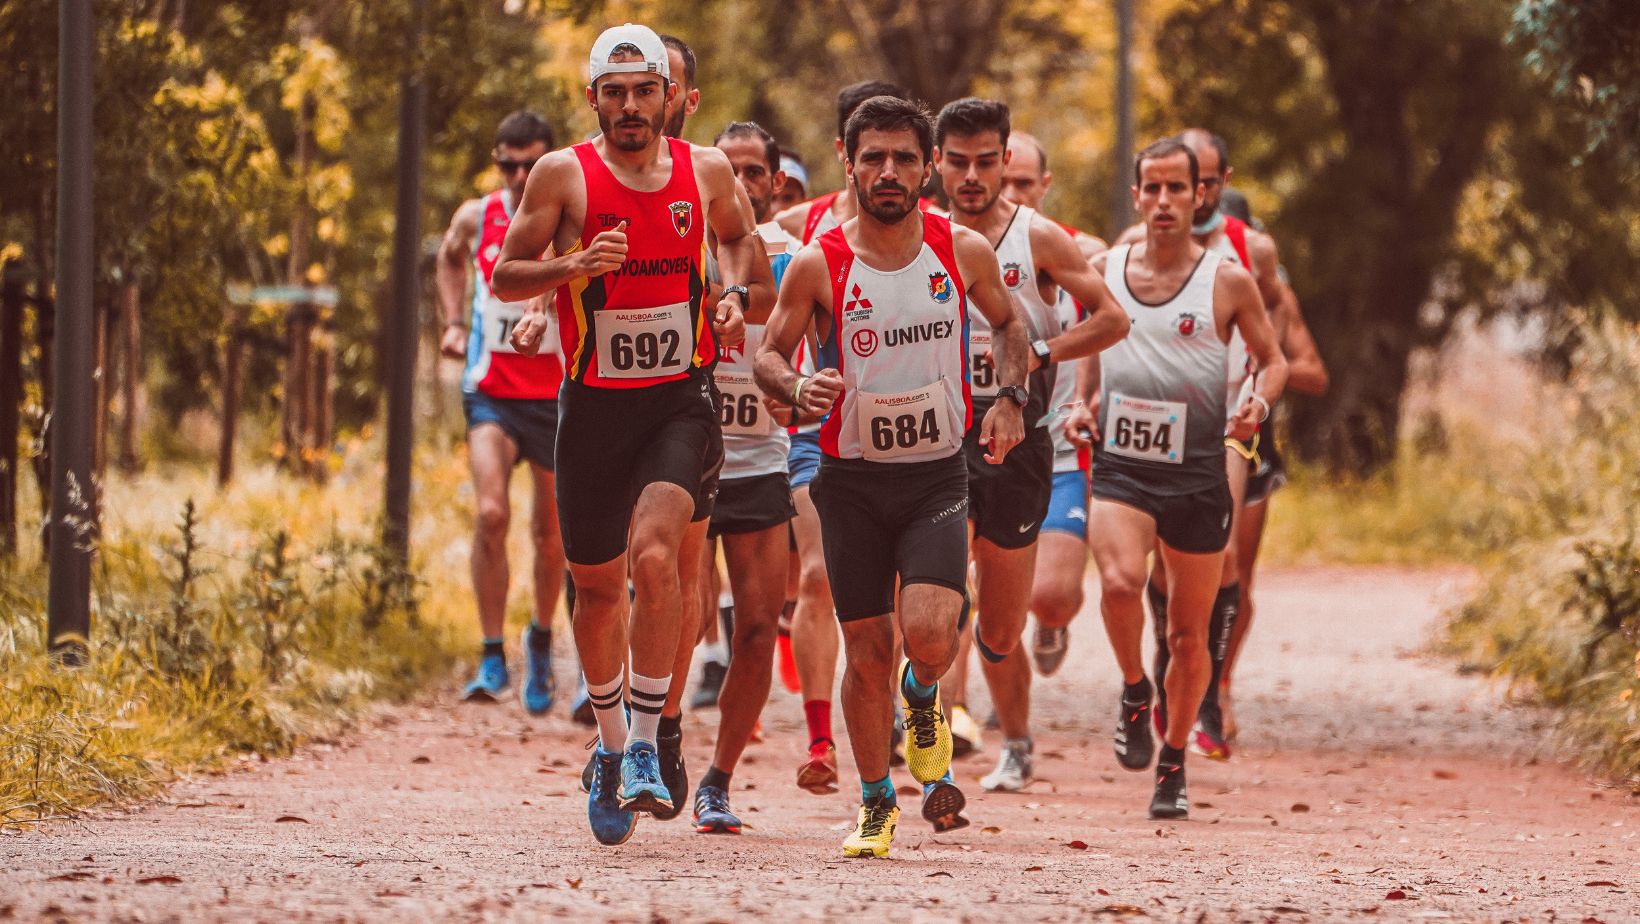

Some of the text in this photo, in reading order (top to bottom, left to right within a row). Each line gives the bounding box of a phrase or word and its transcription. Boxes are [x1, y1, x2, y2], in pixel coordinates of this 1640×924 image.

[604, 256, 689, 277] VOAMOVEIS
[616, 312, 667, 321] AALISBOA.com
[884, 319, 954, 347] UNIVEX
[610, 329, 680, 371] 692
[973, 354, 1001, 389] 5
[875, 393, 925, 405] AALISBOA.com
[870, 407, 941, 452] 684
[1115, 417, 1172, 455] 654
